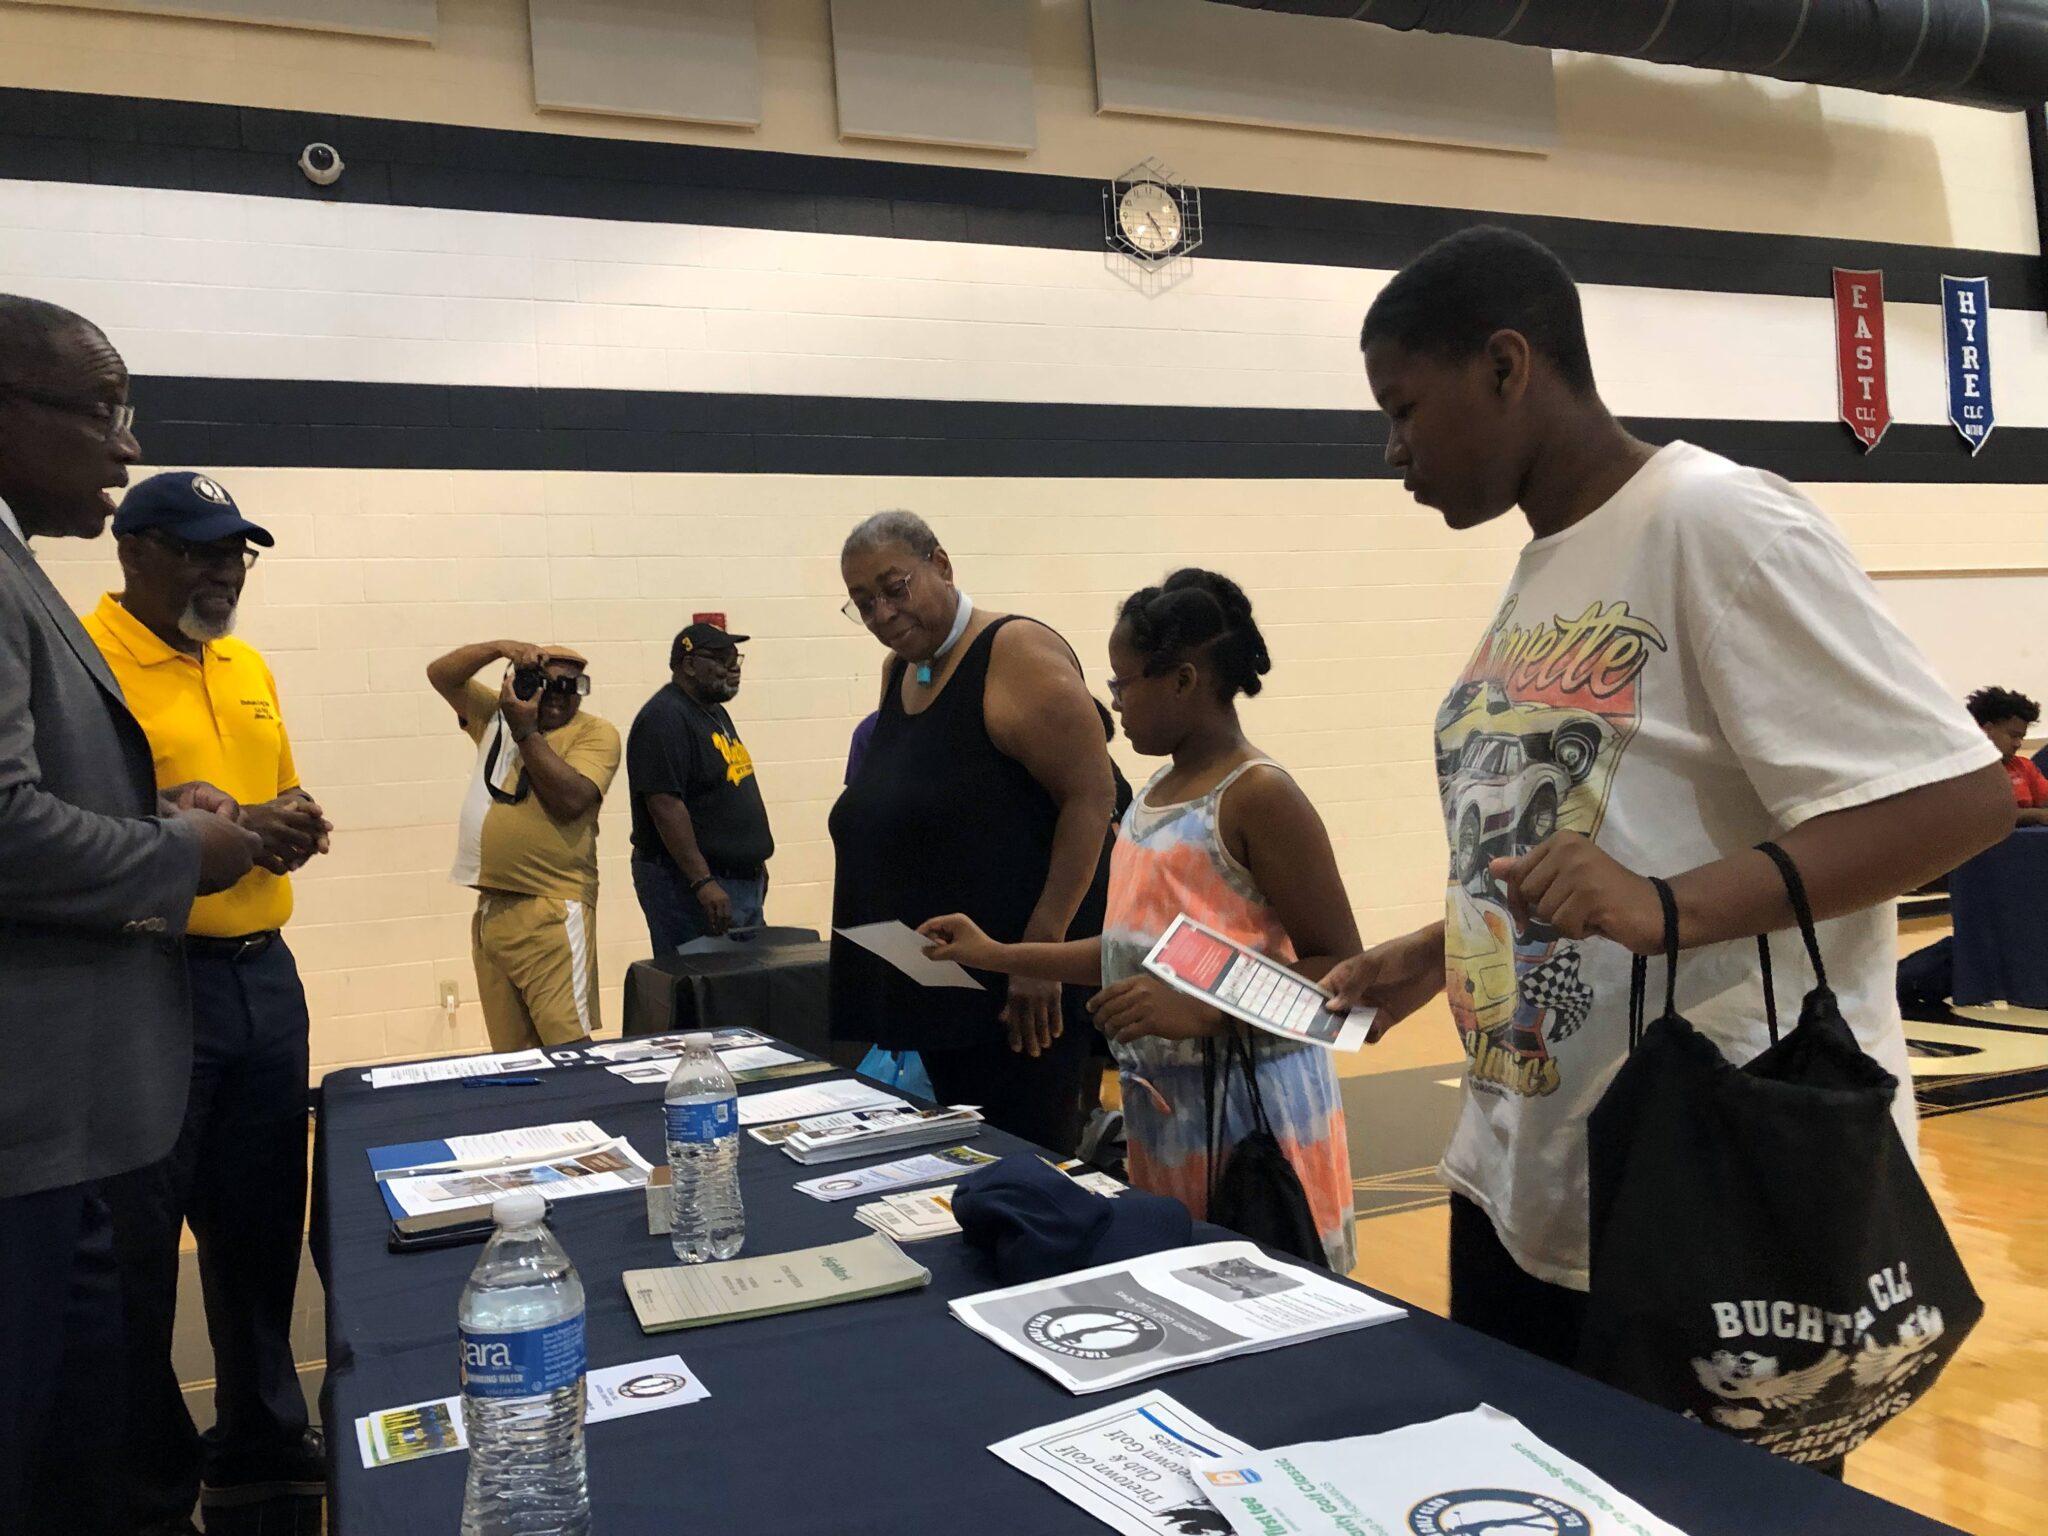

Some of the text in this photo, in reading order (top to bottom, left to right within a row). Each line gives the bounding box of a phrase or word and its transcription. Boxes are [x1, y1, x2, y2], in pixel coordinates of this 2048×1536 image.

[1851, 285, 1874, 400] EAST
[1958, 291, 1980, 397] HYRE
[1963, 405, 1983, 418] CLC
[1711, 1300, 1875, 1346] BUCHT
[1054, 1444, 1163, 1506] Tiretown Golf
[1103, 1428, 1200, 1488] retown Golf
[1123, 1462, 1161, 1482] Club
[1273, 1457, 1315, 1493] Classic
[1305, 1493, 1338, 1514] Golf
